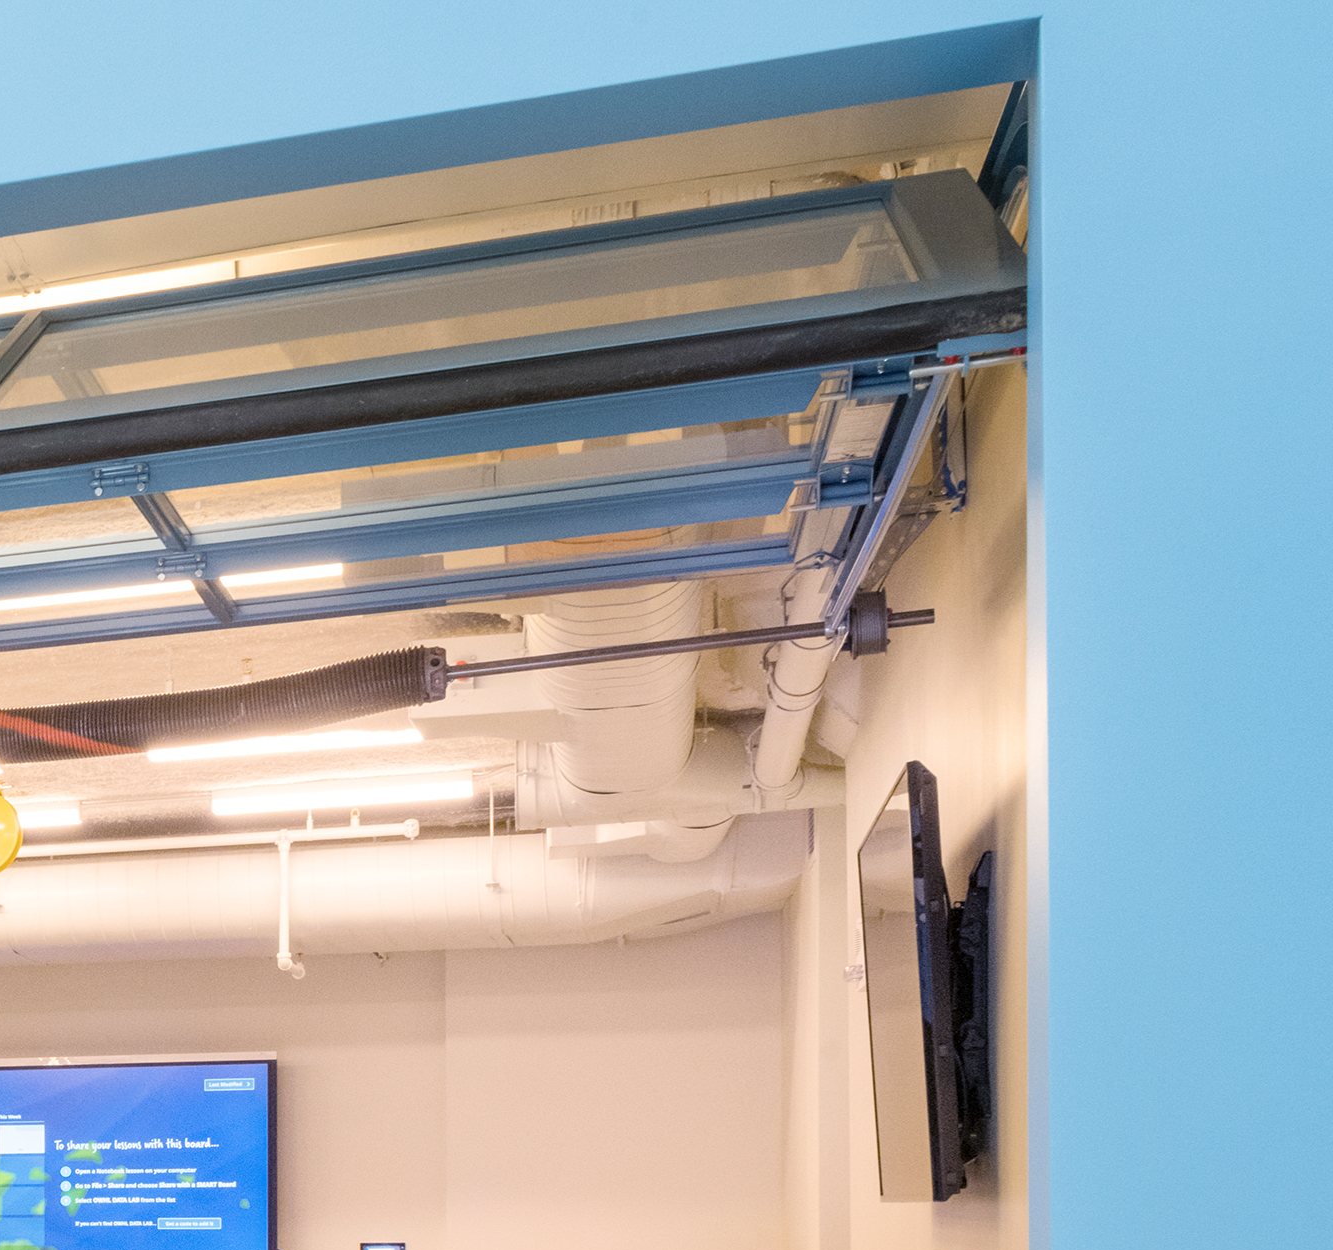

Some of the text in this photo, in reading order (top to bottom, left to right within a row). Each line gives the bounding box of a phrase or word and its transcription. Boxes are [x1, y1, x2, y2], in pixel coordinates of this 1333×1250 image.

[54, 1140, 64, 1150] To
[67, 1140, 89, 1150] share
[91, 1143, 112, 1153] your
[114, 1140, 142, 1150] lessons
[144, 1138, 164, 1149] with
[165, 1138, 182, 1149] this
